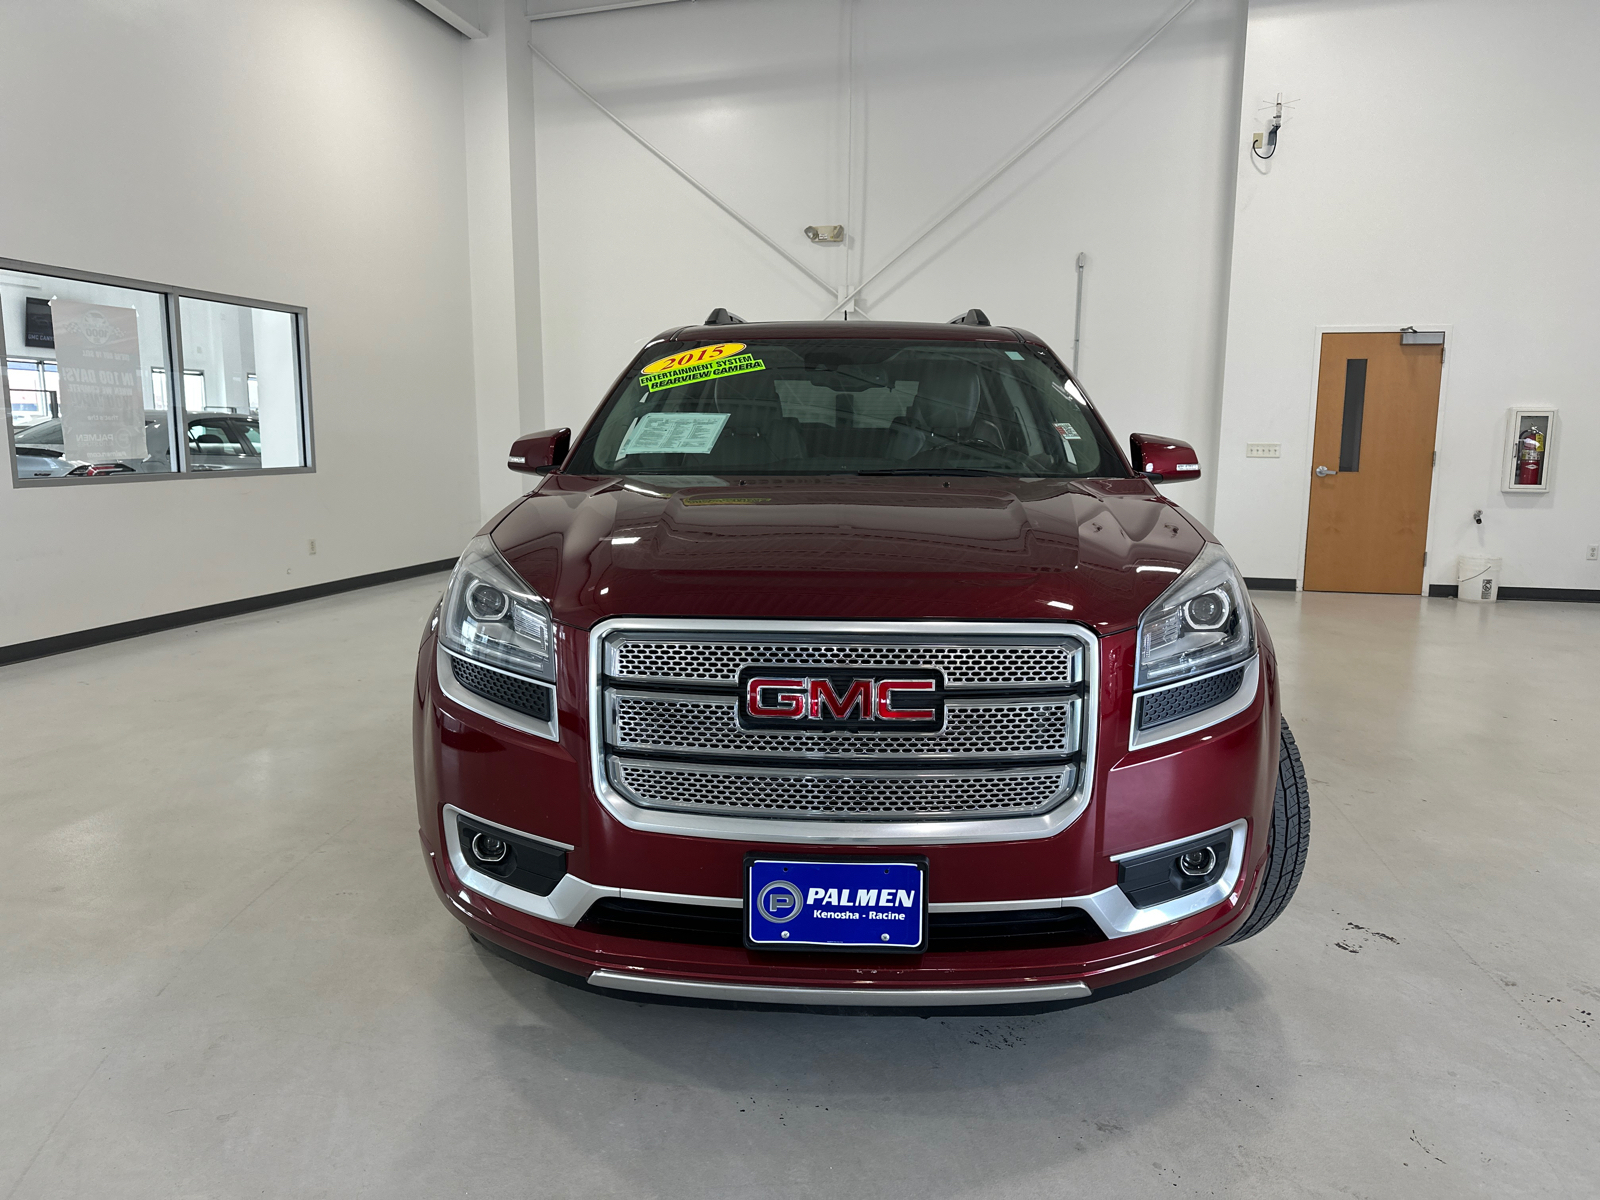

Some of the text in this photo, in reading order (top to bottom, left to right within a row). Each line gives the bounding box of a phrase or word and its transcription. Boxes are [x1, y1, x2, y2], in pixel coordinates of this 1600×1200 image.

[640, 355, 753, 384] ENTERTAINMENT SYSTEM
[660, 345, 725, 371] 2015
[651, 361, 762, 390] REARVIEW CAMERA
[747, 676, 936, 721] GMC
[806, 887, 915, 908] PALMEN
[813, 909, 860, 920] Kenosha
[868, 910, 906, 921] Racine
